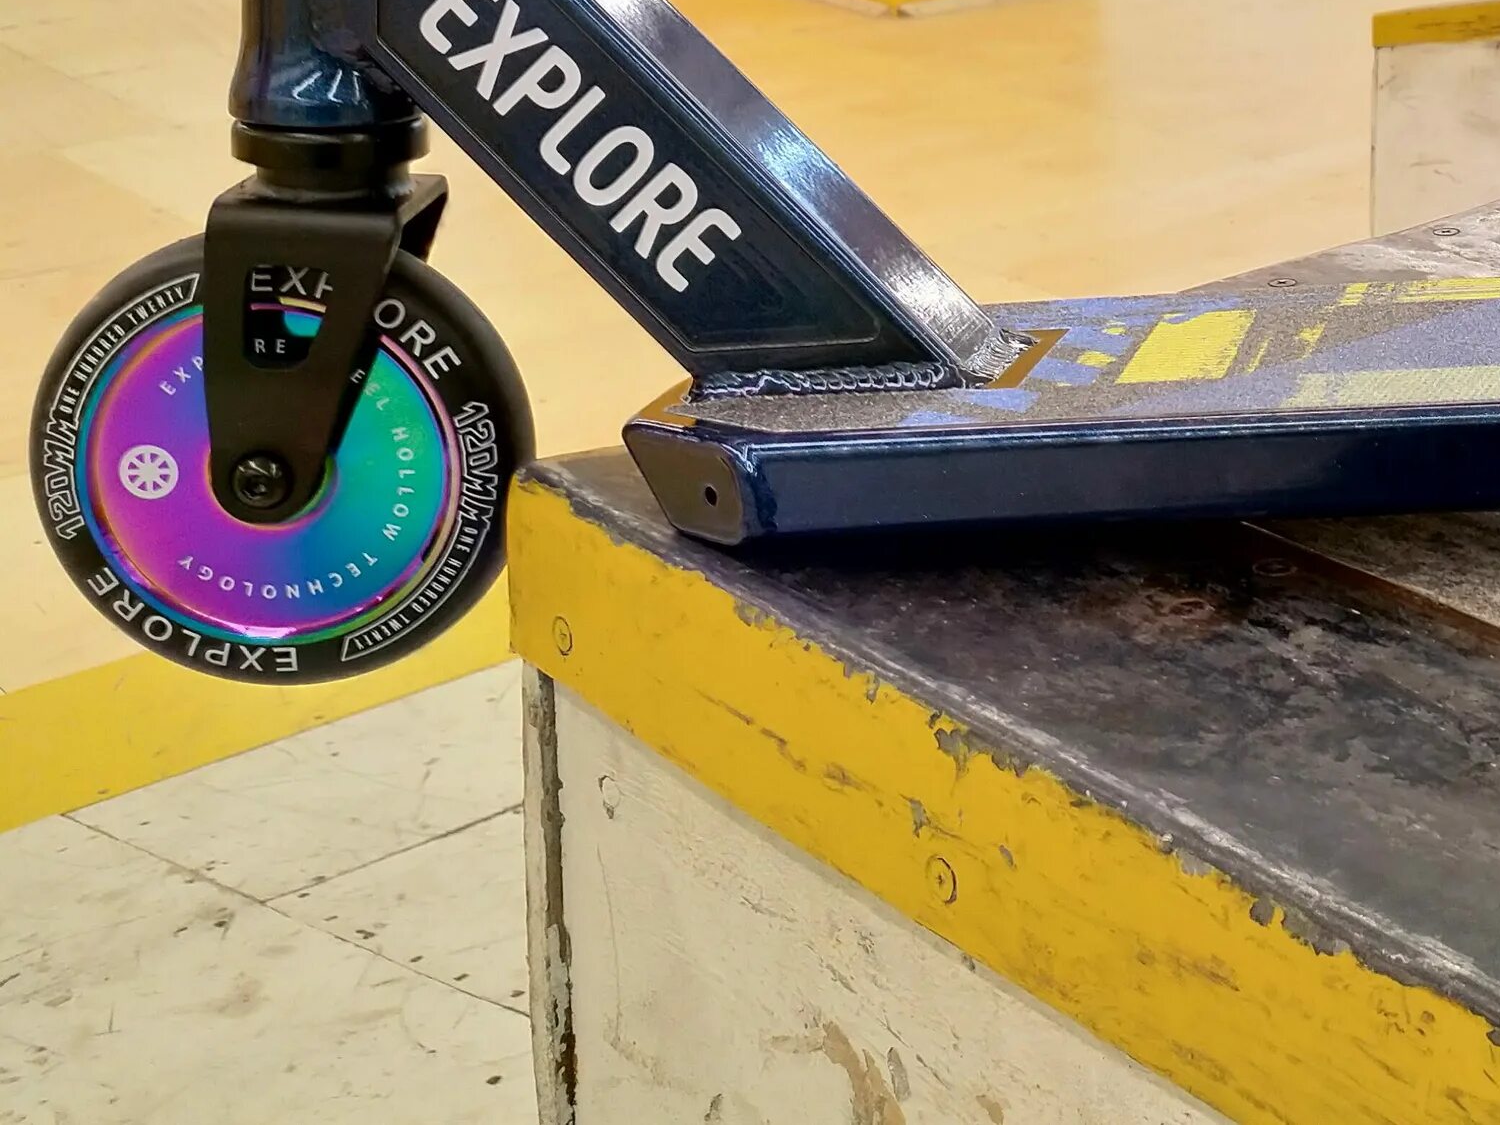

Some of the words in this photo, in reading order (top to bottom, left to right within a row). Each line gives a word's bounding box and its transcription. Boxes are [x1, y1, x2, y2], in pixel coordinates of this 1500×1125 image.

[60, 386, 80, 414] ONE
[74, 324, 126, 382] HUNDRED
[126, 286, 185, 326] TWENTY
[382, 426, 416, 541] HOLLOW
[455, 527, 479, 553] ONE
[177, 552, 378, 599] TECHNOLOGY
[409, 558, 463, 614] HUNDRED
[87, 566, 299, 672] EXPLORE
[355, 615, 411, 651] TWENTY
